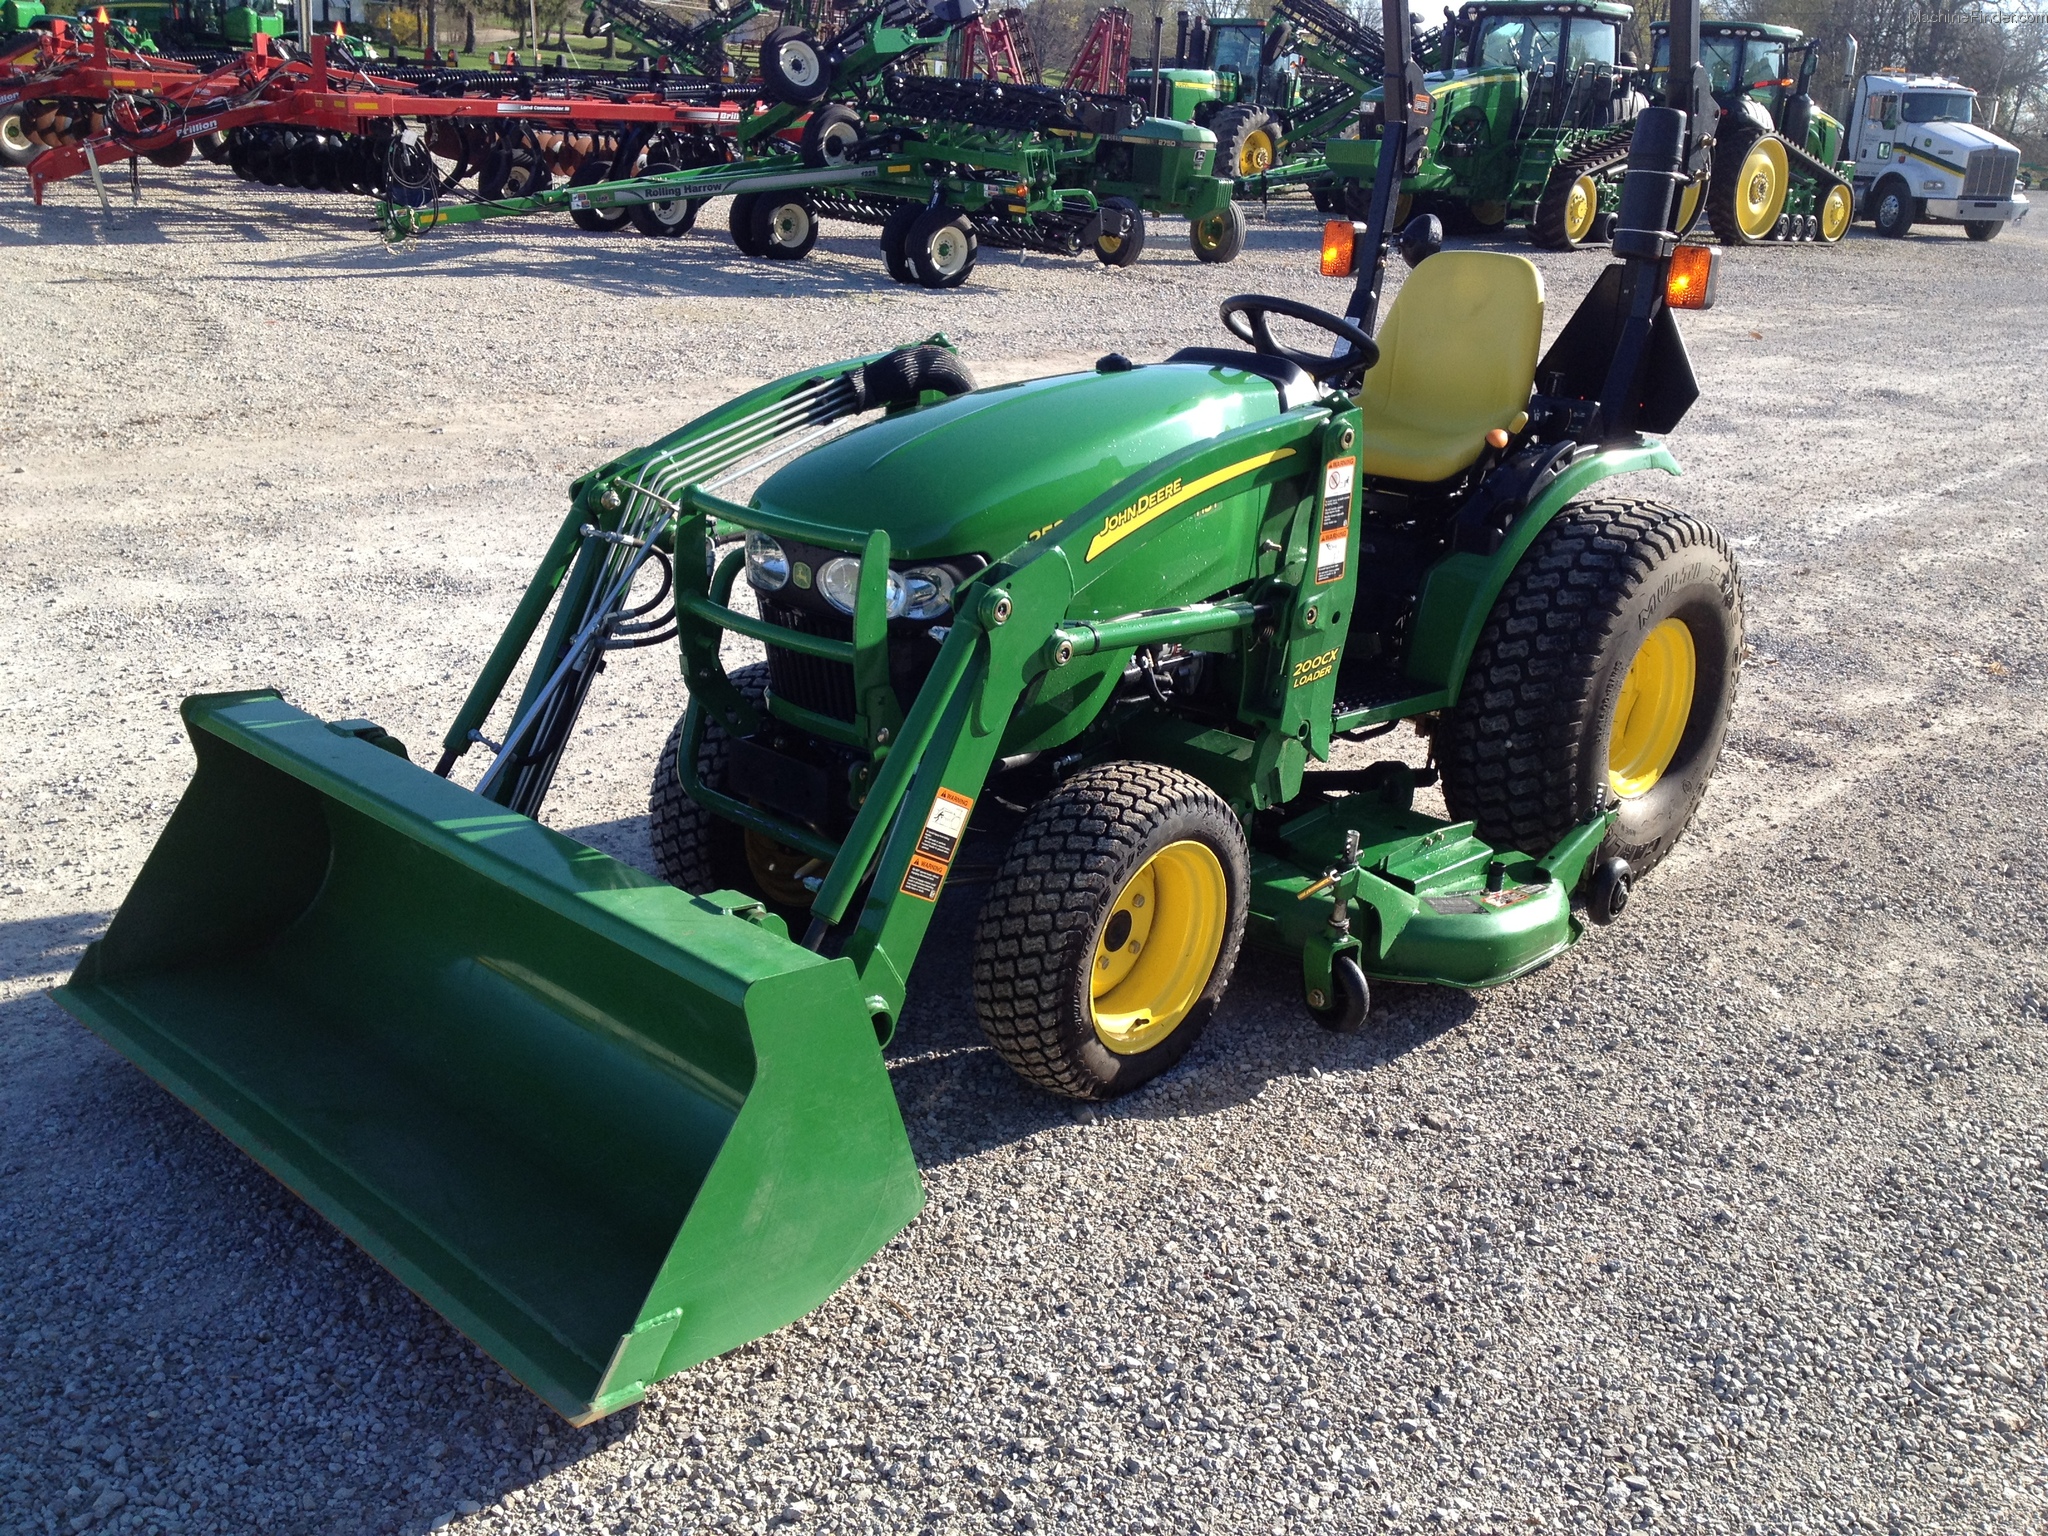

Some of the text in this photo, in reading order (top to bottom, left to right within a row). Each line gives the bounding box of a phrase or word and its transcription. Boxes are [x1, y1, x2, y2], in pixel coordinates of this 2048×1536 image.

[645, 184, 722, 197] Rolling Harrow
[1331, 458, 1354, 468] WARNING
[1100, 504, 1137, 537] JOHN
[1137, 477, 1182, 516] DEERE
[1325, 530, 1347, 541] WARNING
[1293, 647, 1339, 677] 200CX
[1293, 665, 1332, 689] LOADER
[946, 793, 969, 807] WARNING
[921, 862, 943, 873] WARNING
